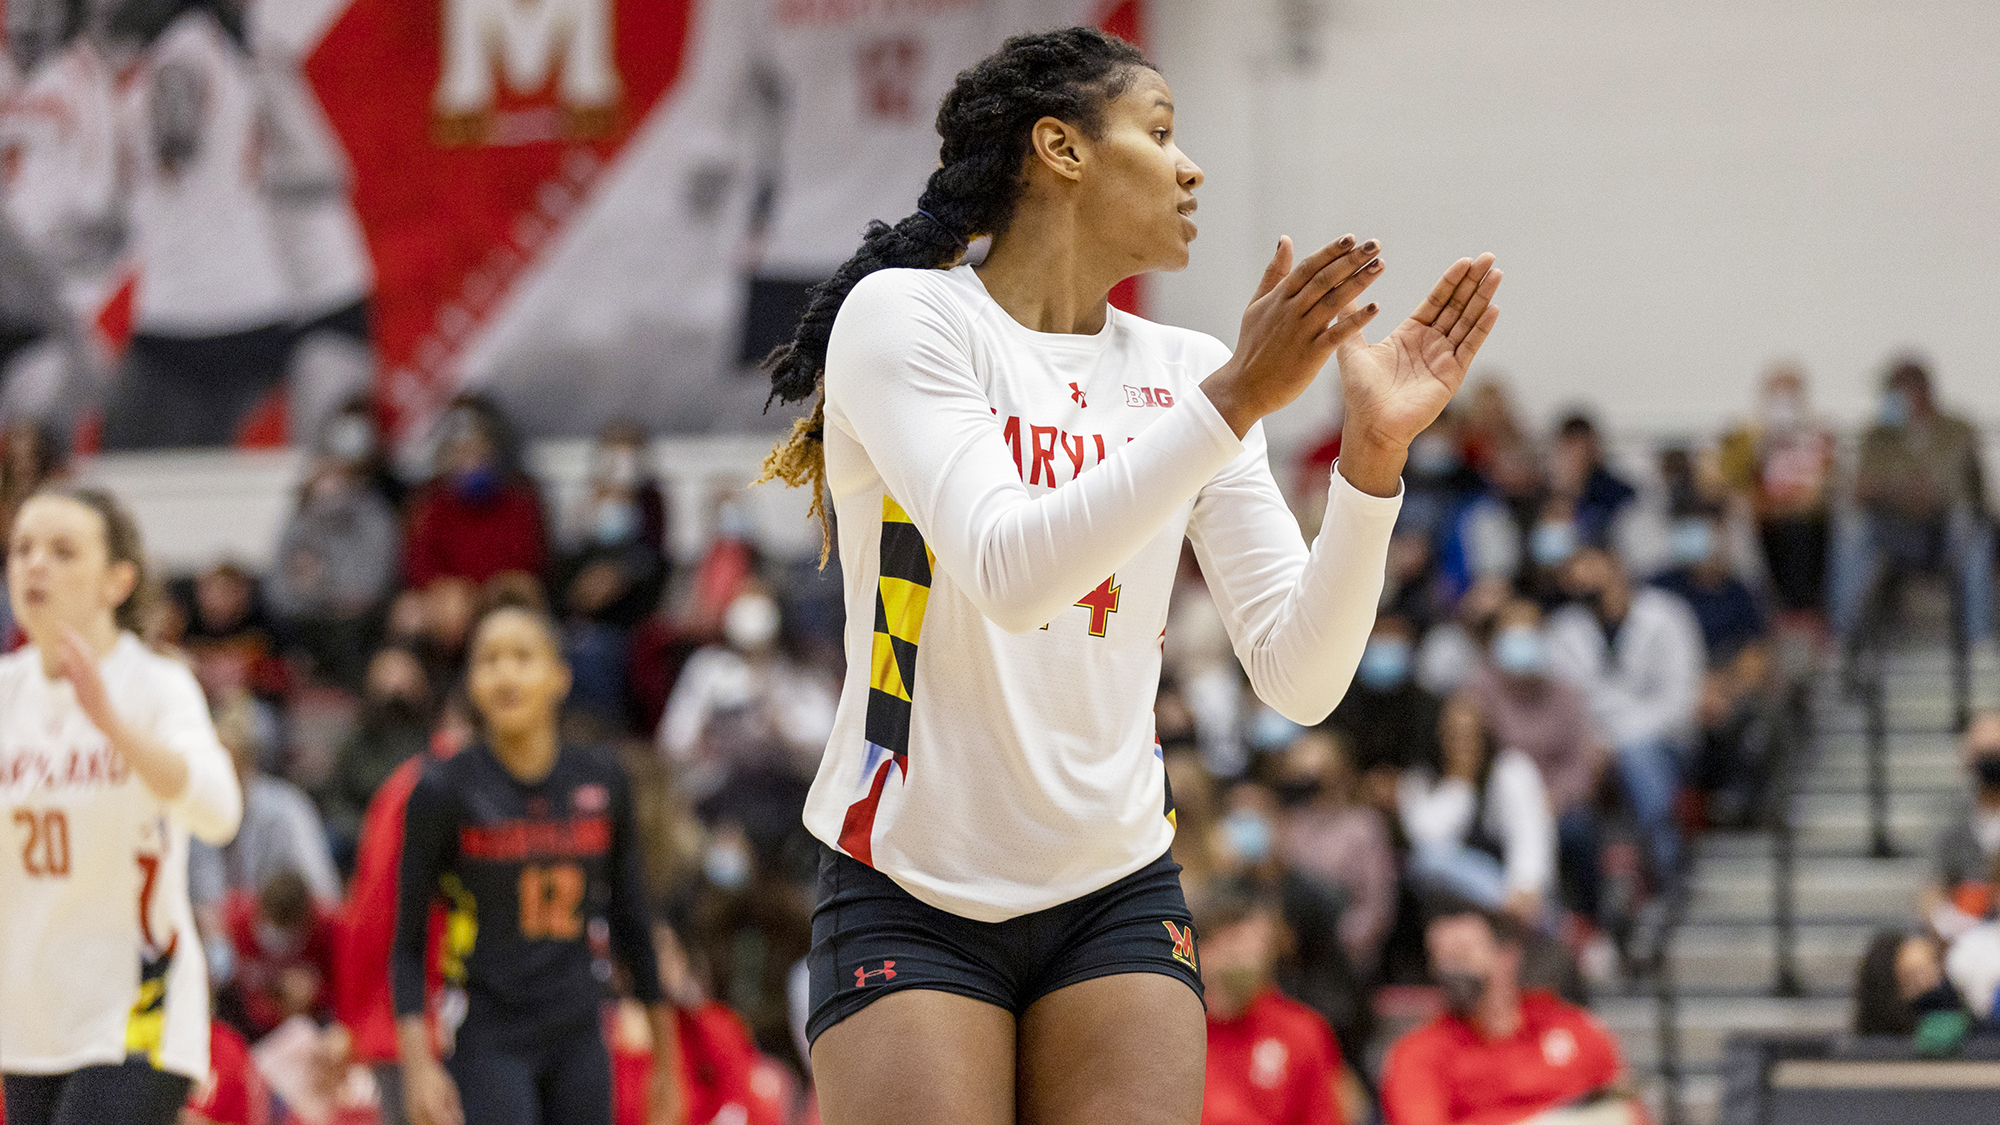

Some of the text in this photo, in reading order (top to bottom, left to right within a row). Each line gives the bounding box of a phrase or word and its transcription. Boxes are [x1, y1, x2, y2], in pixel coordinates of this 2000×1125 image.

[431, 0, 624, 118] M
[1039, 572, 1122, 638] 4
[12, 806, 70, 880] 20
[1162, 920, 1197, 967] M
